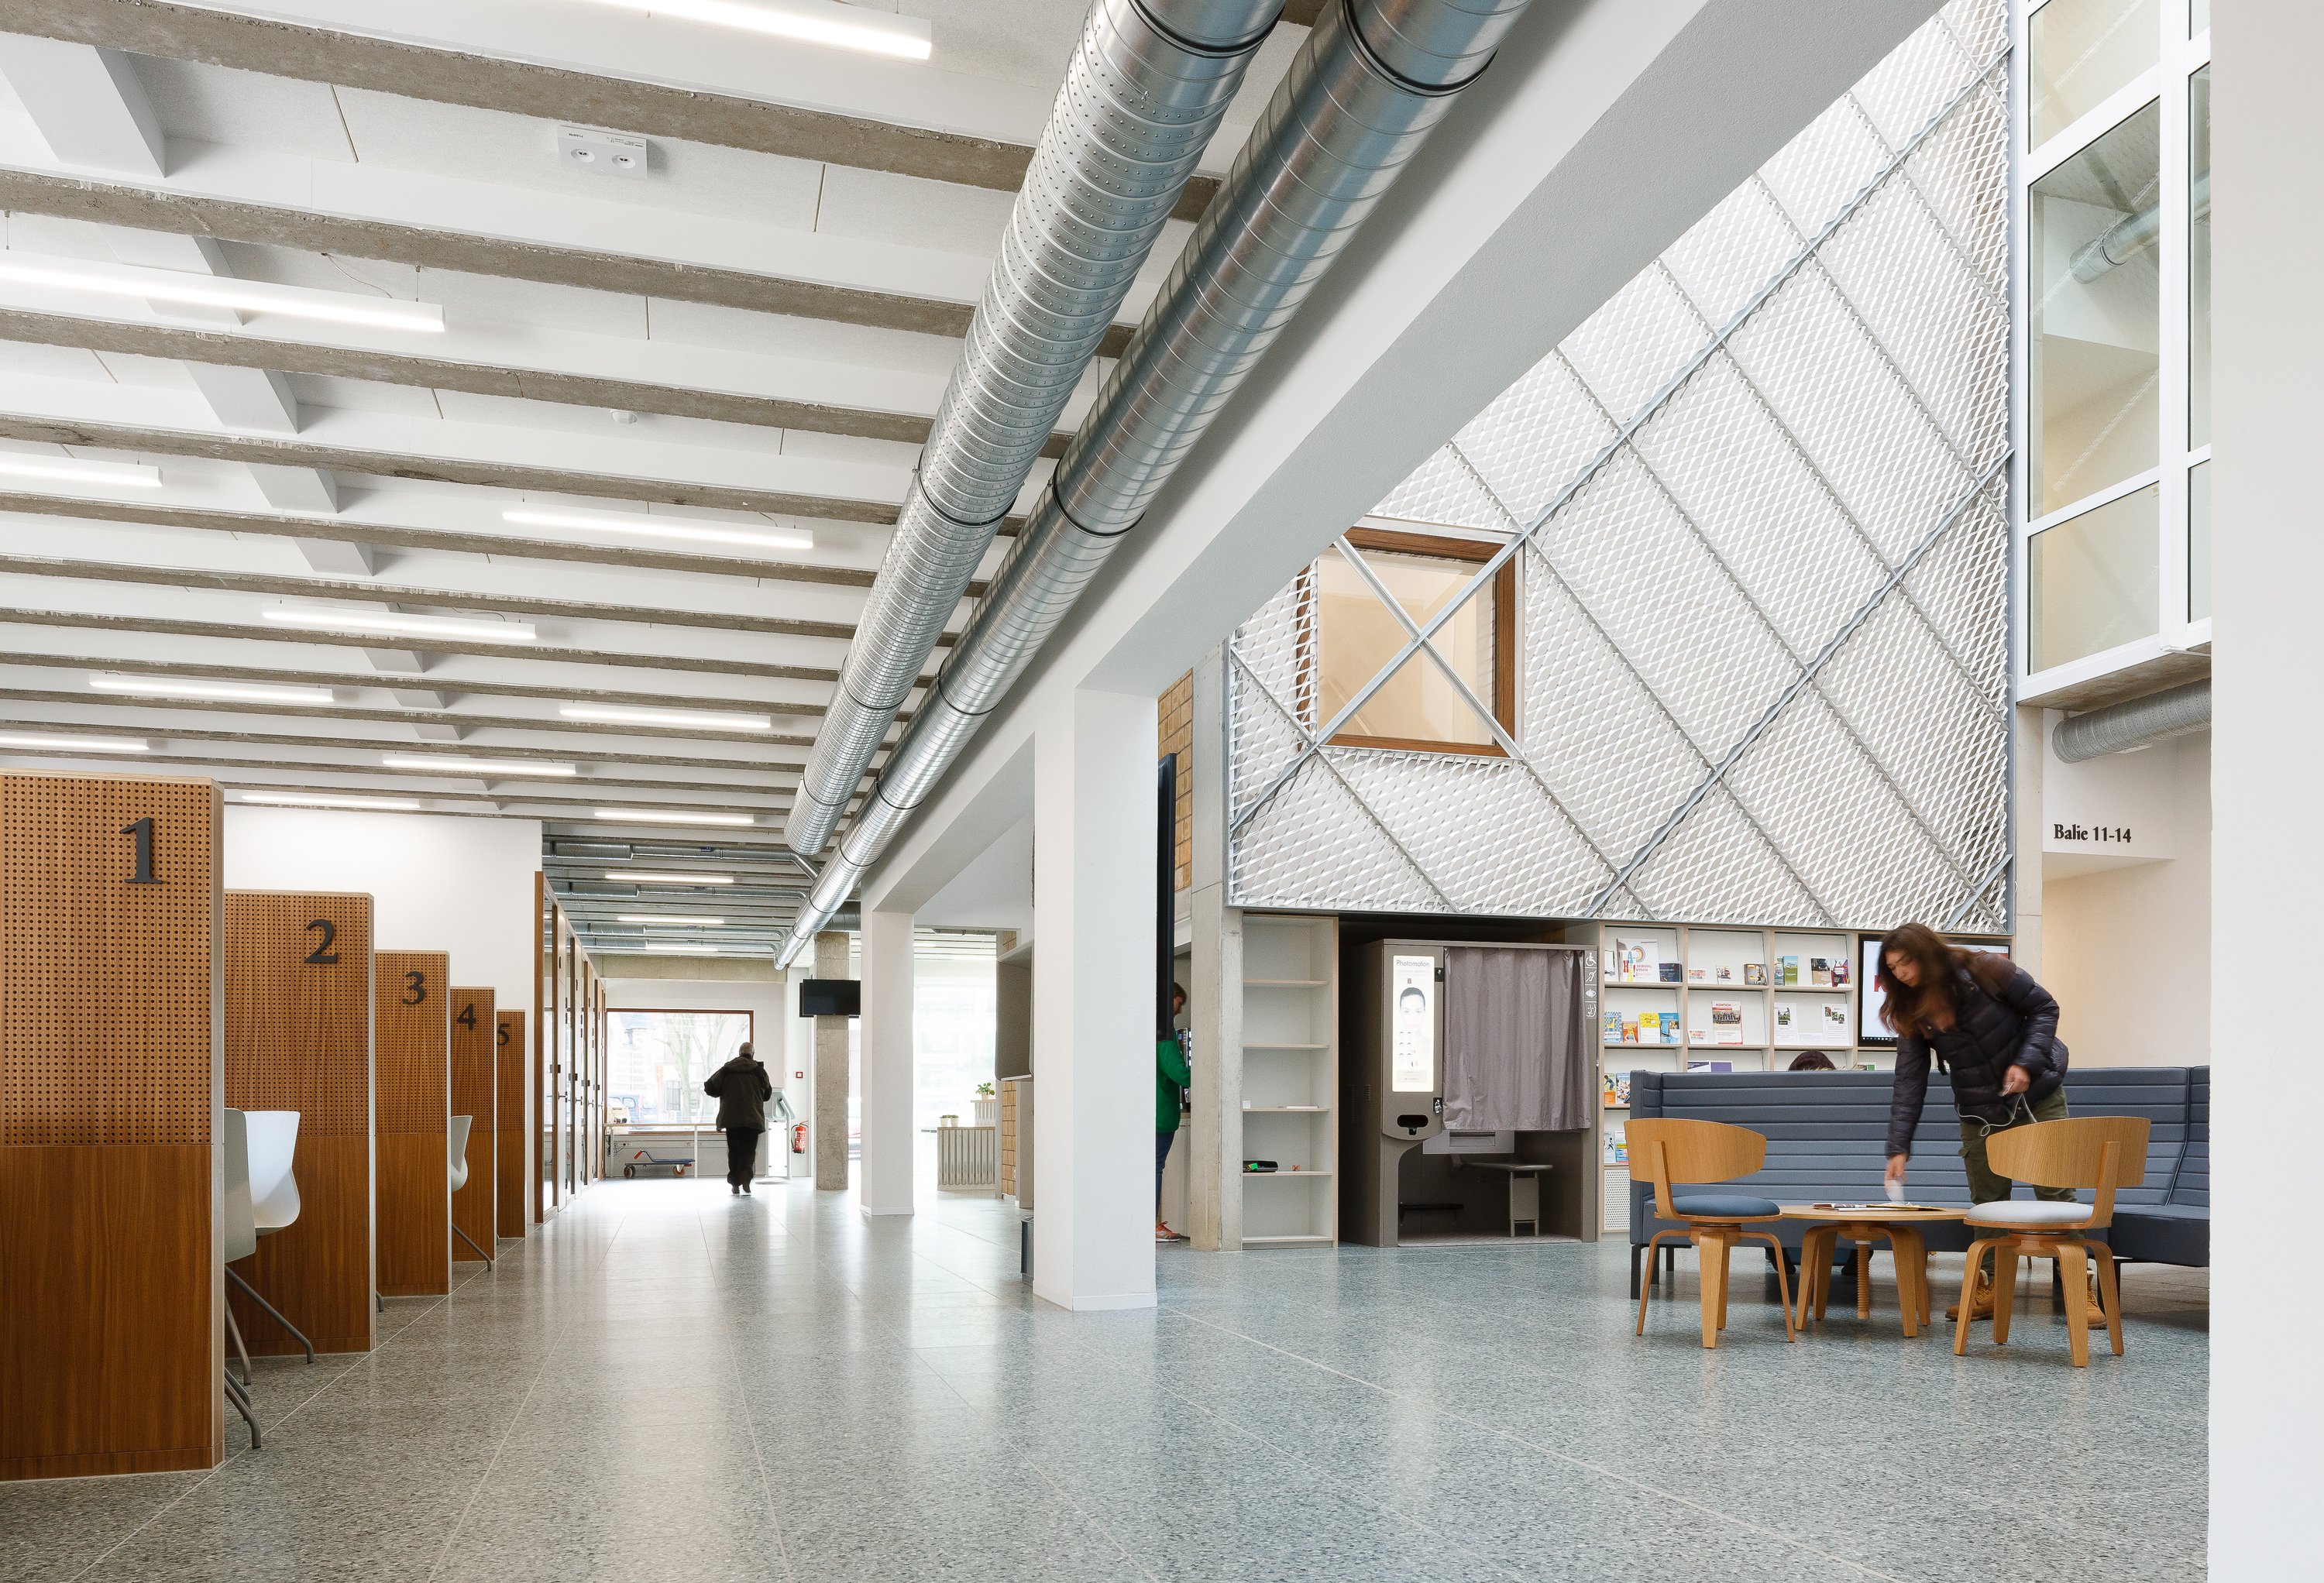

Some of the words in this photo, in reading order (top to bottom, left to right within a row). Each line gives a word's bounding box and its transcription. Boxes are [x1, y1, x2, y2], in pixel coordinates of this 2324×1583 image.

[2053, 823, 2089, 841] Balie
[2092, 826, 2132, 843] 11-14
[119, 817, 163, 884] 1
[304, 919, 338, 964] 2
[402, 970, 425, 1004] 3
[456, 1004, 476, 1031] 4
[497, 1023, 511, 1046] 5
